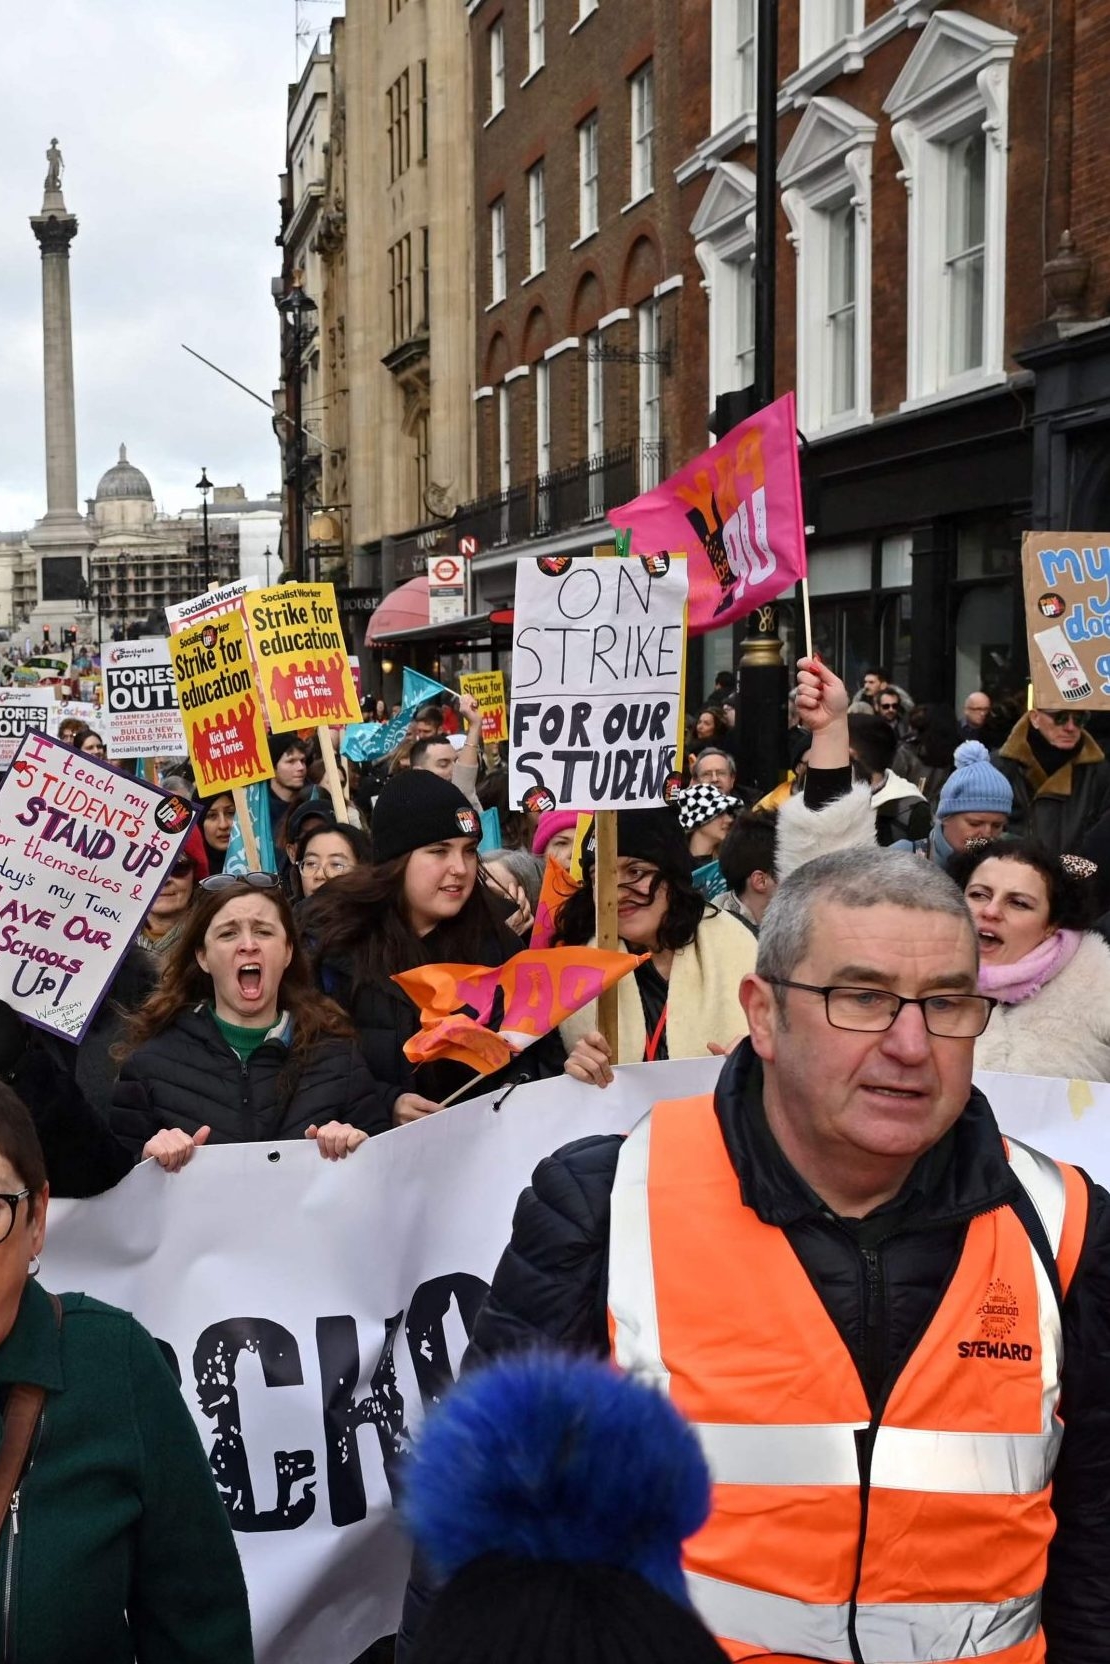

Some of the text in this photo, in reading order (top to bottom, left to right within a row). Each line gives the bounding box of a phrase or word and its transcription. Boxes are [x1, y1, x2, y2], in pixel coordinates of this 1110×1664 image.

[461, 539, 475, 553] N
[558, 565, 652, 619] ON
[252, 602, 309, 632] Strike
[311, 601, 333, 625] for
[180, 632, 203, 649] Socialis
[259, 627, 341, 656] education
[175, 637, 243, 682] Strike for
[516, 625, 681, 689] STRIKE
[108, 668, 174, 686] TORIES
[181, 668, 251, 711] education
[294, 674, 326, 687] Kick out
[464, 681, 501, 695] Strike for
[110, 685, 178, 710] OUT!
[294, 685, 332, 700] the Tories
[151, 711, 177, 719] LABOUR
[513, 701, 671, 747] FOR OUR
[111, 732, 183, 742] WORKERS' PARTY
[208, 726, 238, 744] Kick out
[111, 744, 183, 753] socialistparty.org.uk
[209, 740, 244, 760] the Tories
[25, 737, 150, 819] I teach my
[515, 745, 678, 808] STUDENTS
[16, 764, 170, 851] STUDENTS to
[167, 796, 190, 816] PAY
[15, 796, 163, 878] STAND UP
[24, 835, 123, 893] themselves
[130, 884, 144, 901] &
[48, 884, 76, 909] my
[957, 1341, 1033, 1361] STEWARD
